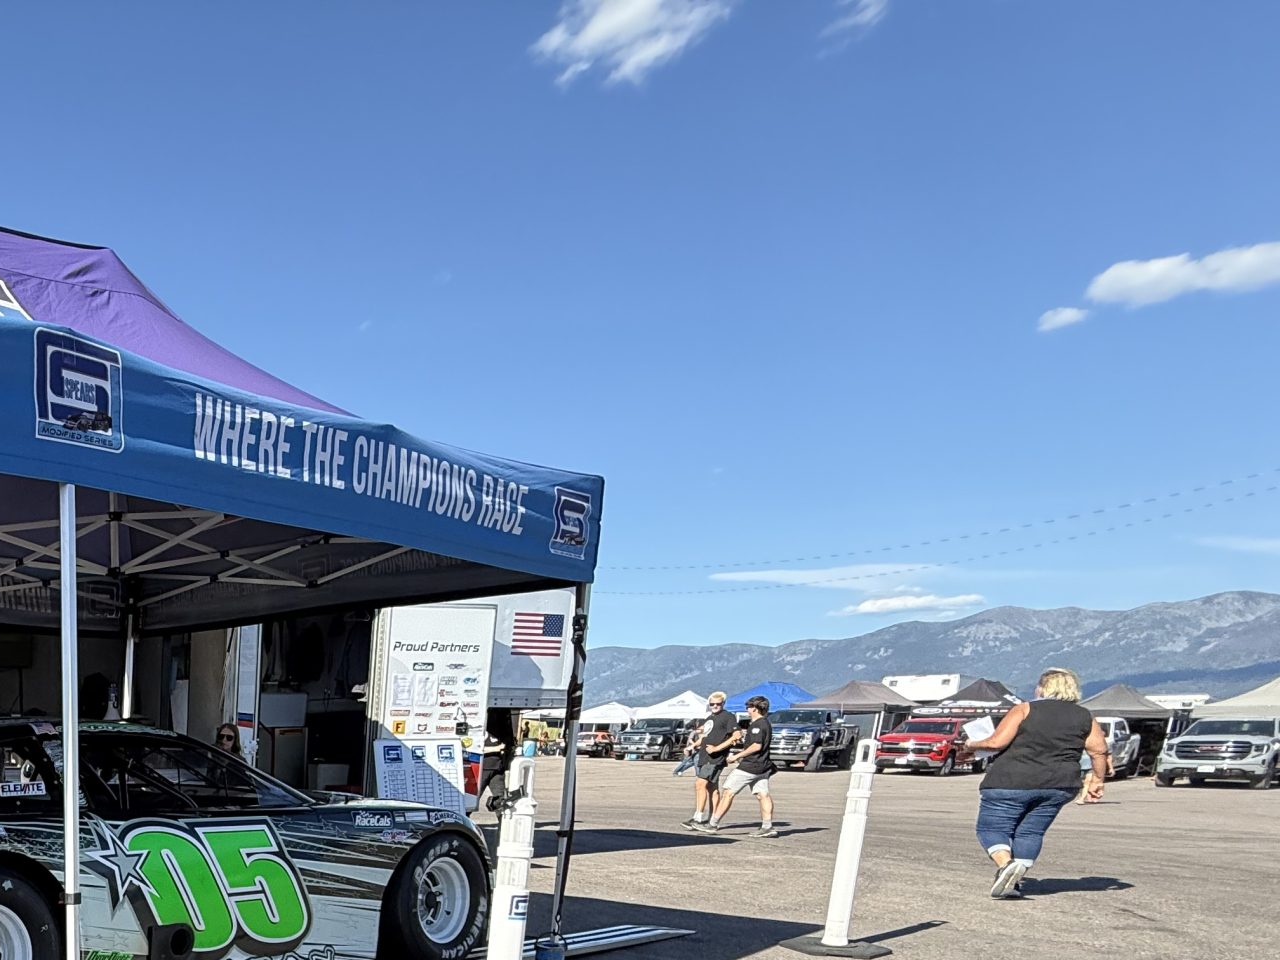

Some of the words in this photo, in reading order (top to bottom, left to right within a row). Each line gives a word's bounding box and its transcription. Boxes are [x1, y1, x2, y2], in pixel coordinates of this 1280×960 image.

[62, 376, 97, 406] SPEARS
[41, 425, 83, 442] MODIFIED
[83, 433, 114, 448] SERIES
[193, 392, 292, 480] WHERE
[301, 420, 349, 491] THE
[351, 434, 478, 524] CHAMPIONS
[476, 472, 529, 537] RACE
[392, 640, 429, 652] Proud
[430, 641, 480, 652] Partners
[0, 782, 44, 794] ELEVATE
[355, 814, 391, 827] RaceCals
[124, 822, 312, 955] 05
[441, 896, 487, 960] AMERICAN
